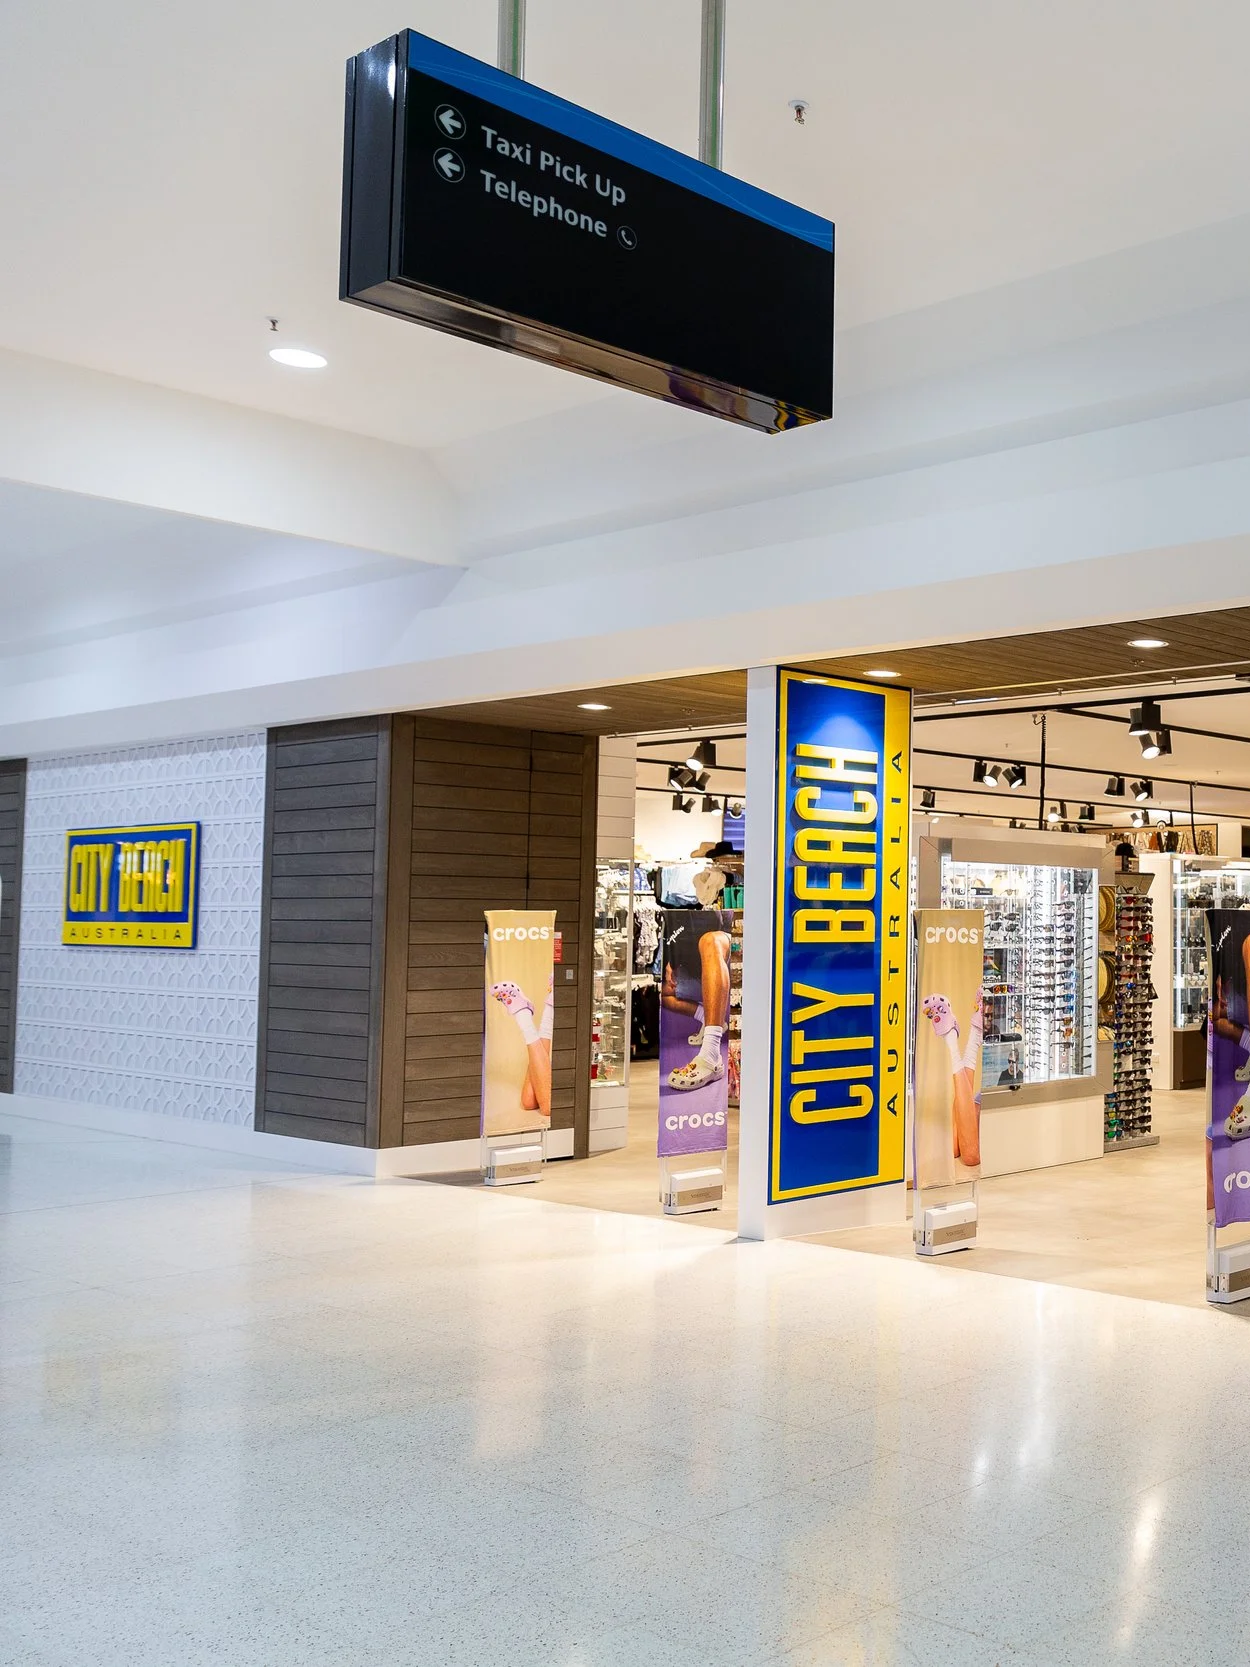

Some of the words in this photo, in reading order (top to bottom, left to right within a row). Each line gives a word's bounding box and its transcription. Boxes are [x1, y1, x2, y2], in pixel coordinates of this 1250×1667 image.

[480, 125, 532, 166] Taxi
[540, 151, 588, 190] Pick
[594, 174, 626, 206] Up
[480, 169, 608, 238] Telephone
[68, 843, 114, 912] CITY
[118, 838, 187, 912] BEACH
[792, 743, 879, 944] BEACH
[69, 927, 183, 941] AUSTRALIA
[492, 925, 550, 942] crocs
[887, 749, 904, 1117] AUSTRALIA
[925, 926, 979, 945] crocs
[789, 981, 876, 1126] CITY
[665, 1110, 726, 1131] crocs
